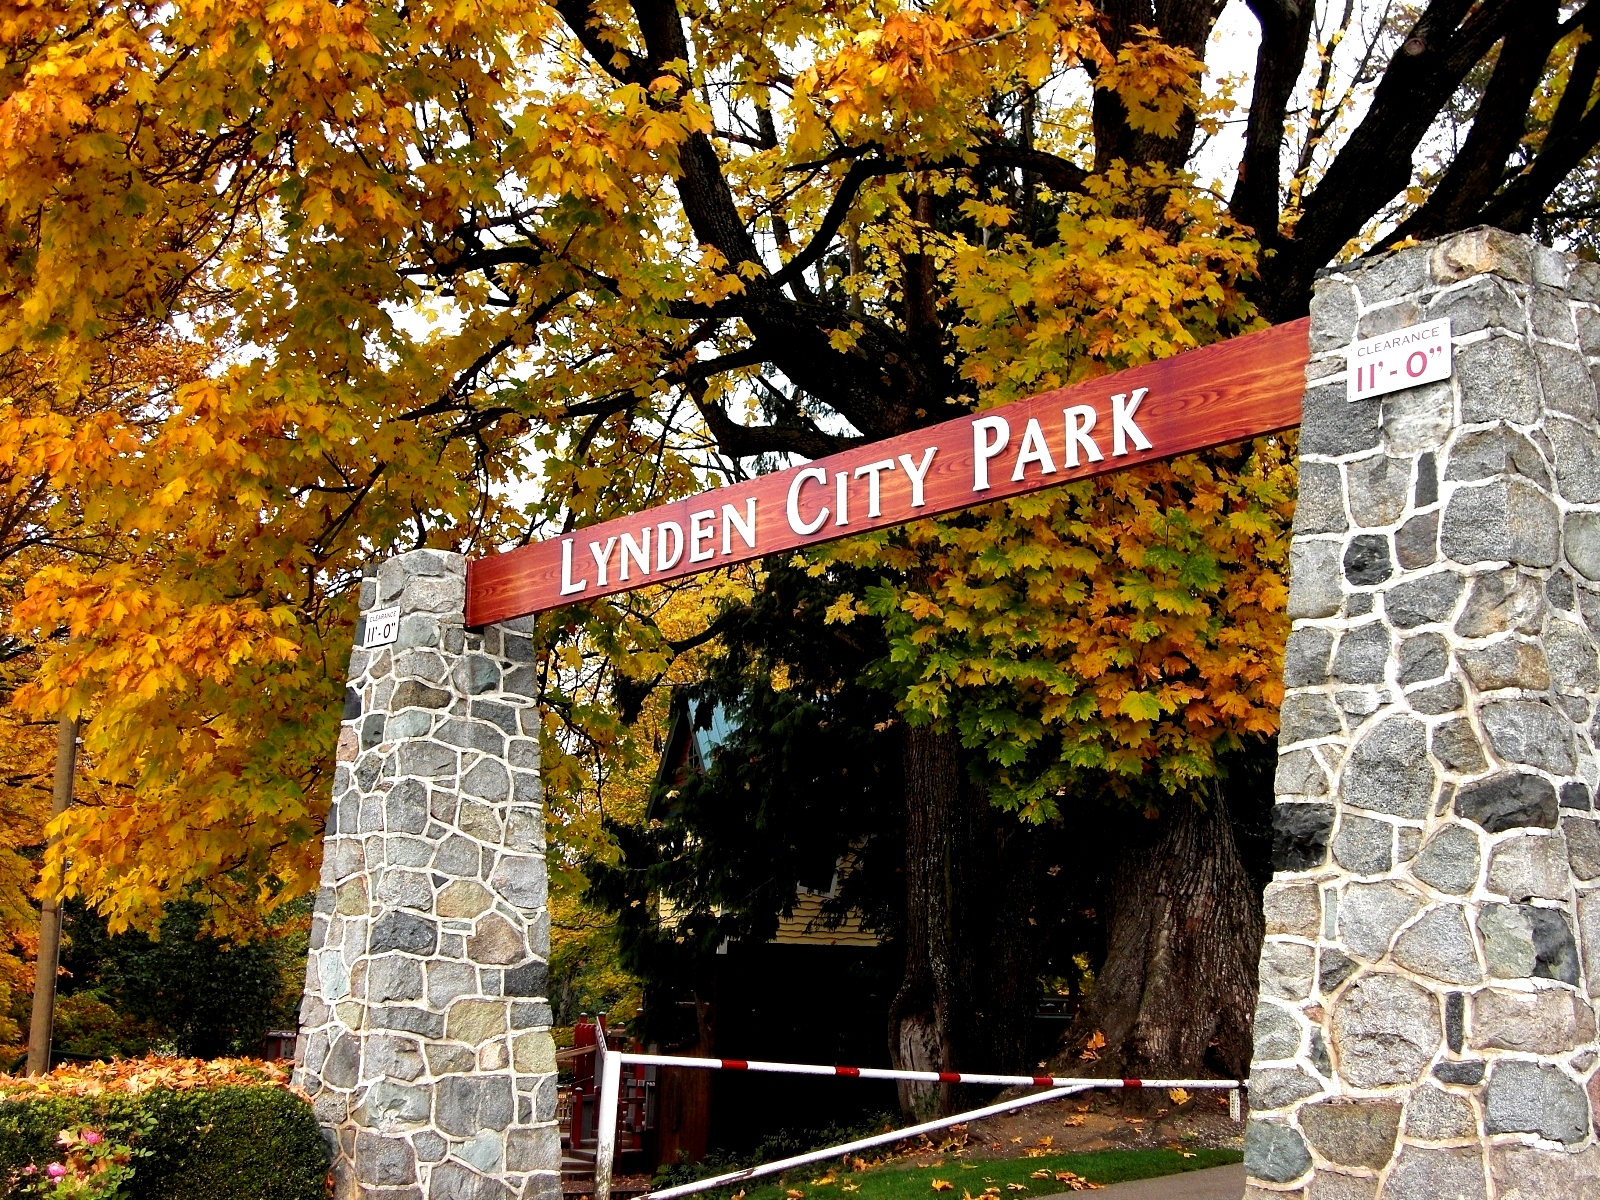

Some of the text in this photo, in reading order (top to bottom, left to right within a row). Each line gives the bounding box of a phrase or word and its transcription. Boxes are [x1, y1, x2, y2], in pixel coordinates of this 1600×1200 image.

[1357, 326, 1440, 358] CLEARANCE
[559, 387, 1153, 596] LYNDEN CITY PARK
[369, 610, 397, 623] CLEARANCE
